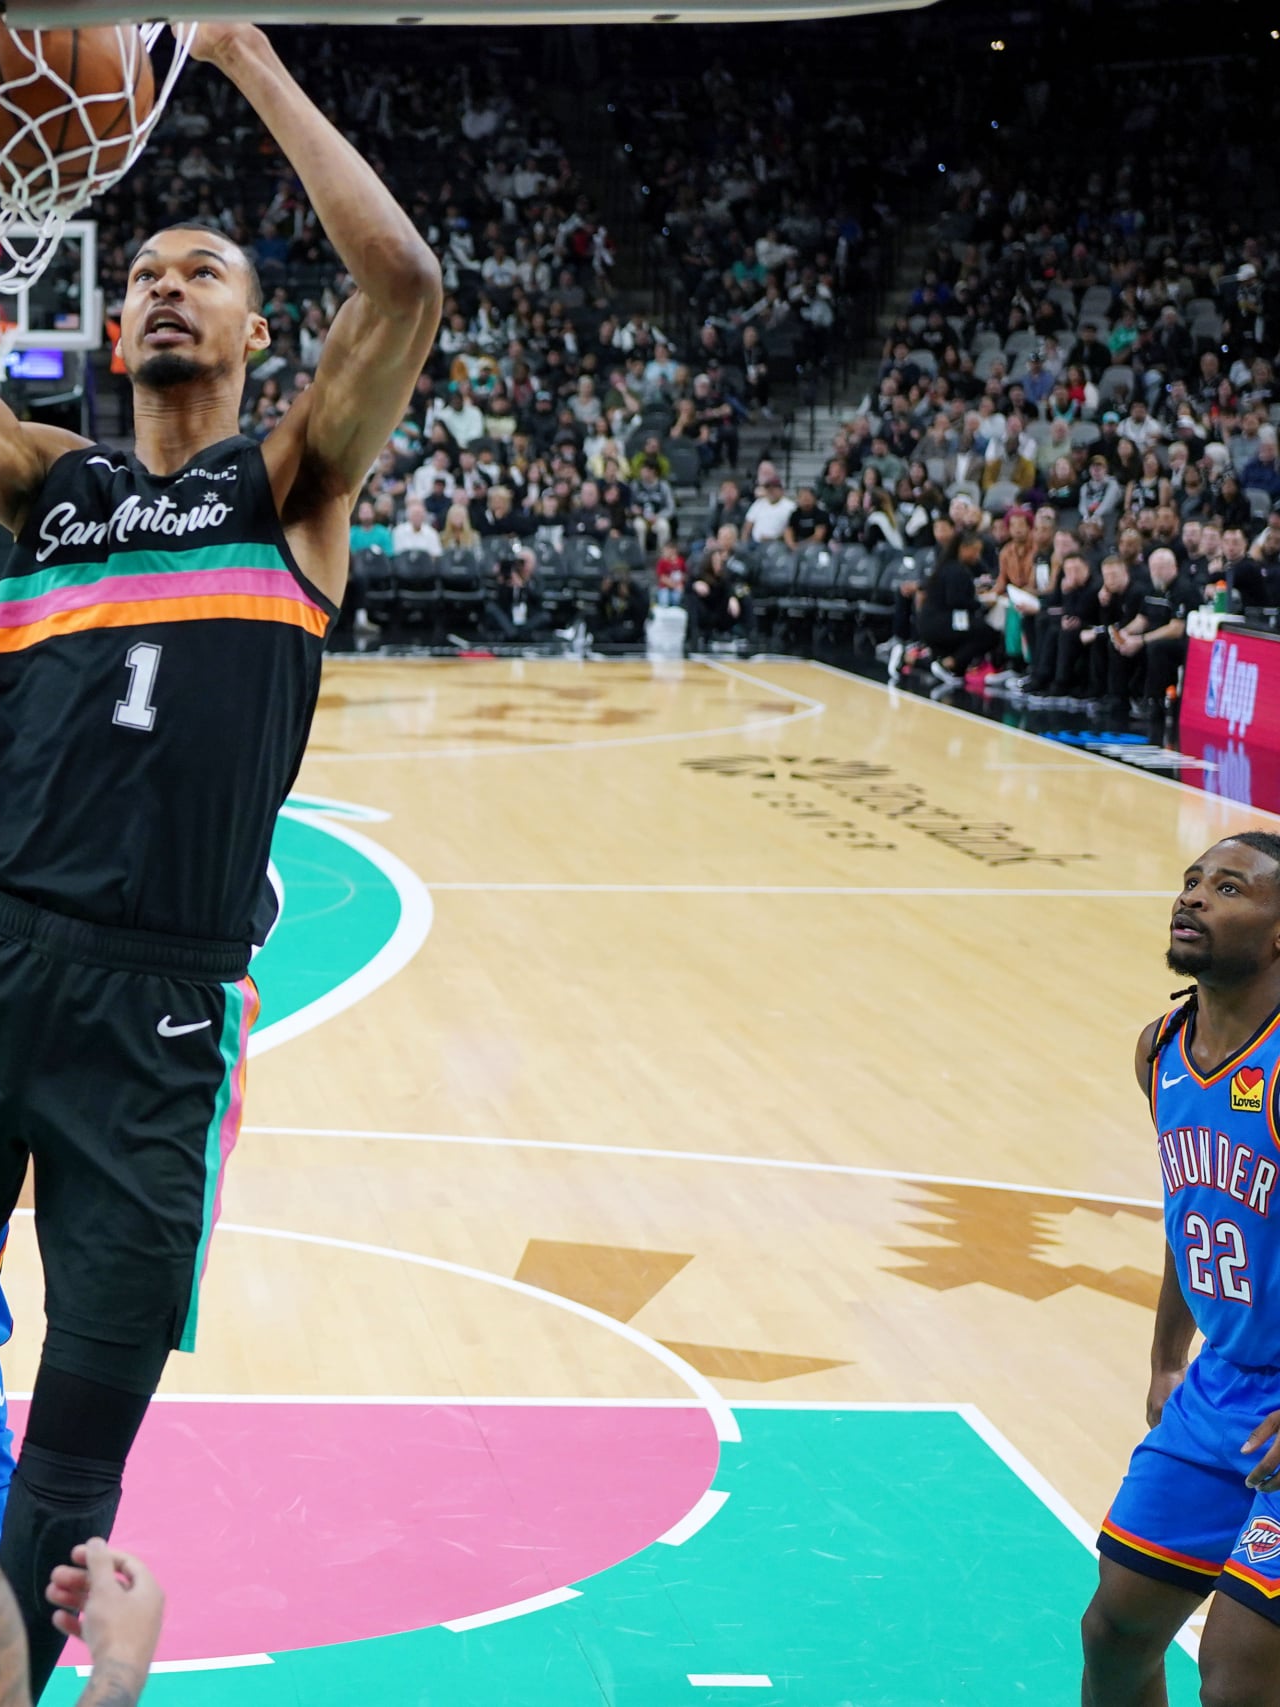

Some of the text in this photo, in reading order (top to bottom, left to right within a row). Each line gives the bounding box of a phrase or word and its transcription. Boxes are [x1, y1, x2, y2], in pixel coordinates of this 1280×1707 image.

[107, 491, 233, 544] Antonio
[112, 641, 163, 732] 1
[1232, 1094, 1261, 1109] Love's
[1158, 1126, 1276, 1218] THUNDER
[1184, 1211, 1252, 1307] 22
